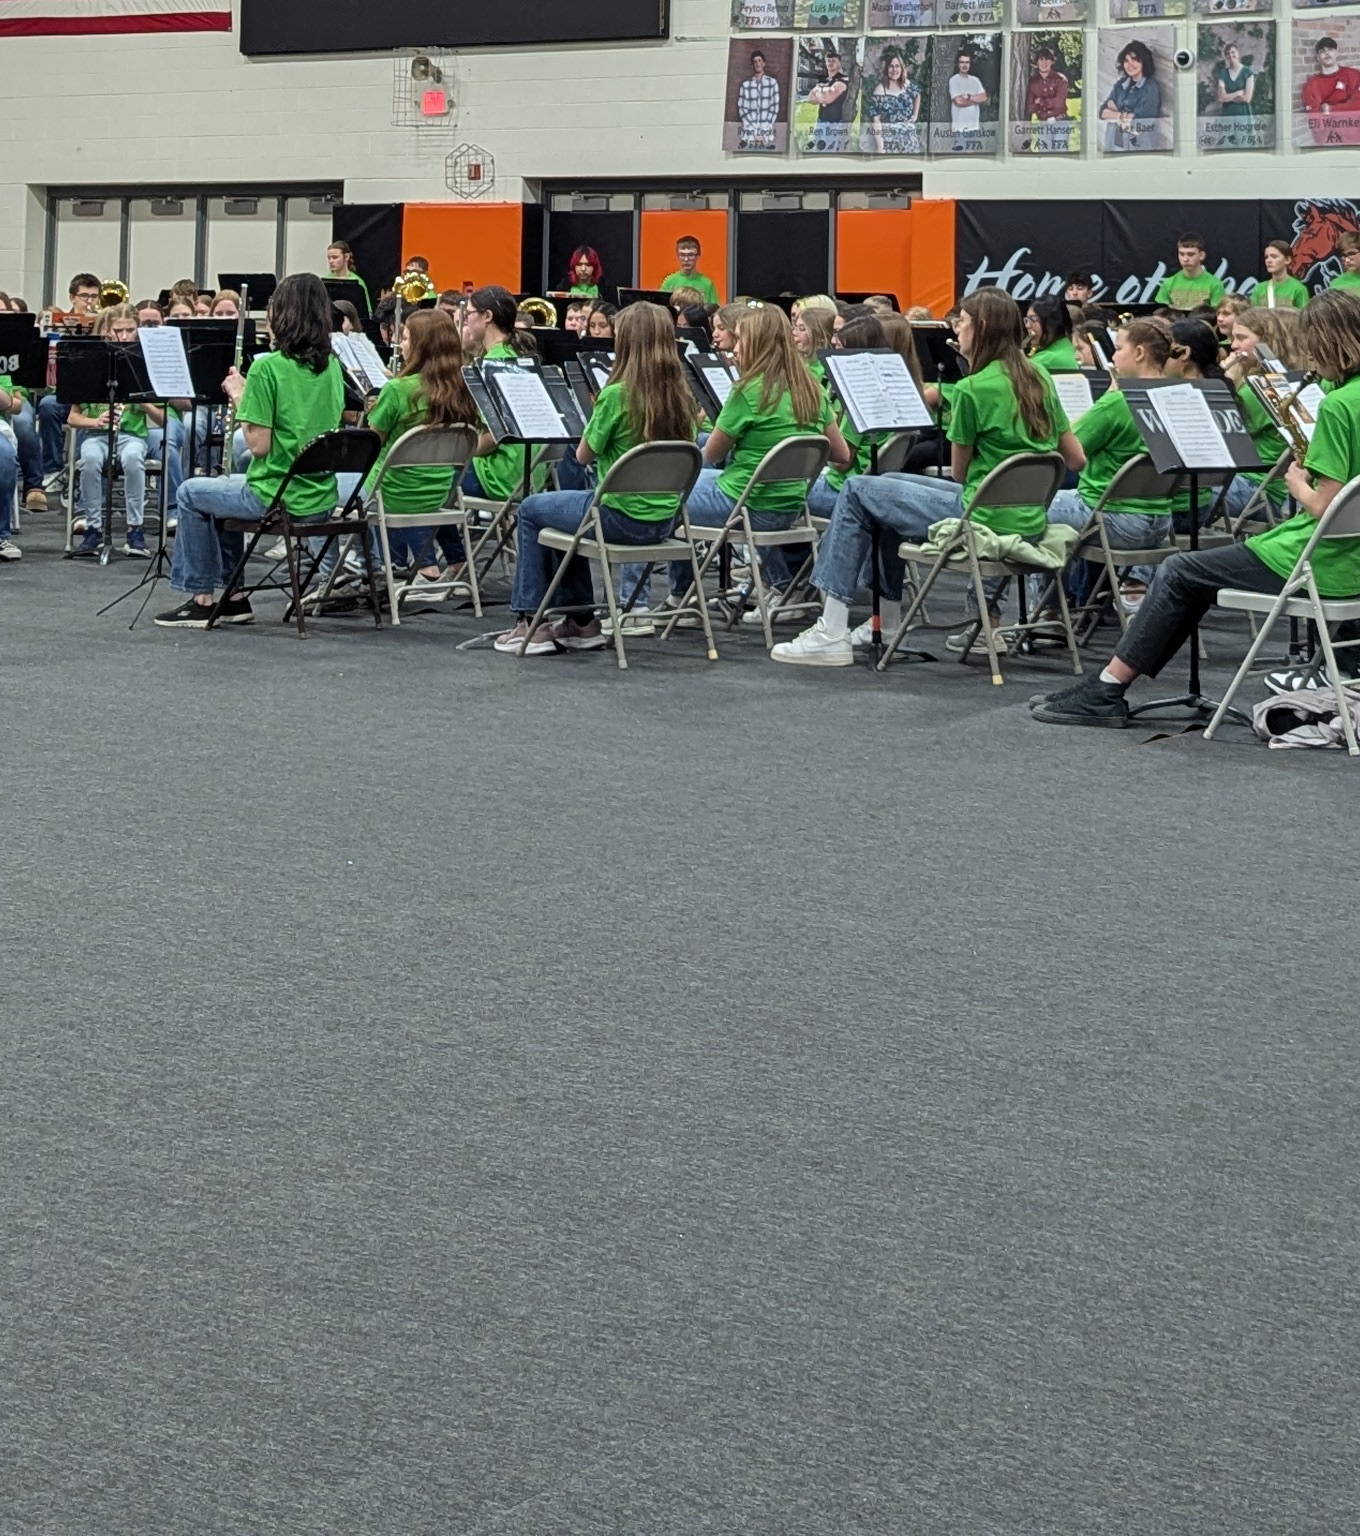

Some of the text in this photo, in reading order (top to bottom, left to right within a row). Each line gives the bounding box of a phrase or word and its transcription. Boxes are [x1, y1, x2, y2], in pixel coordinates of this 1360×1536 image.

[945, 0, 976, 11] Barrett
[1136, 122, 1155, 134] Baer
[1206, 122, 1232, 133] Esther
[1308, 117, 1360, 129] Eli Warnke
[934, 127, 961, 138] Austin
[1015, 123, 1075, 135] Garrett Hansen
[966, 140, 983, 150] FFA
[1051, 138, 1069, 149] FFA
